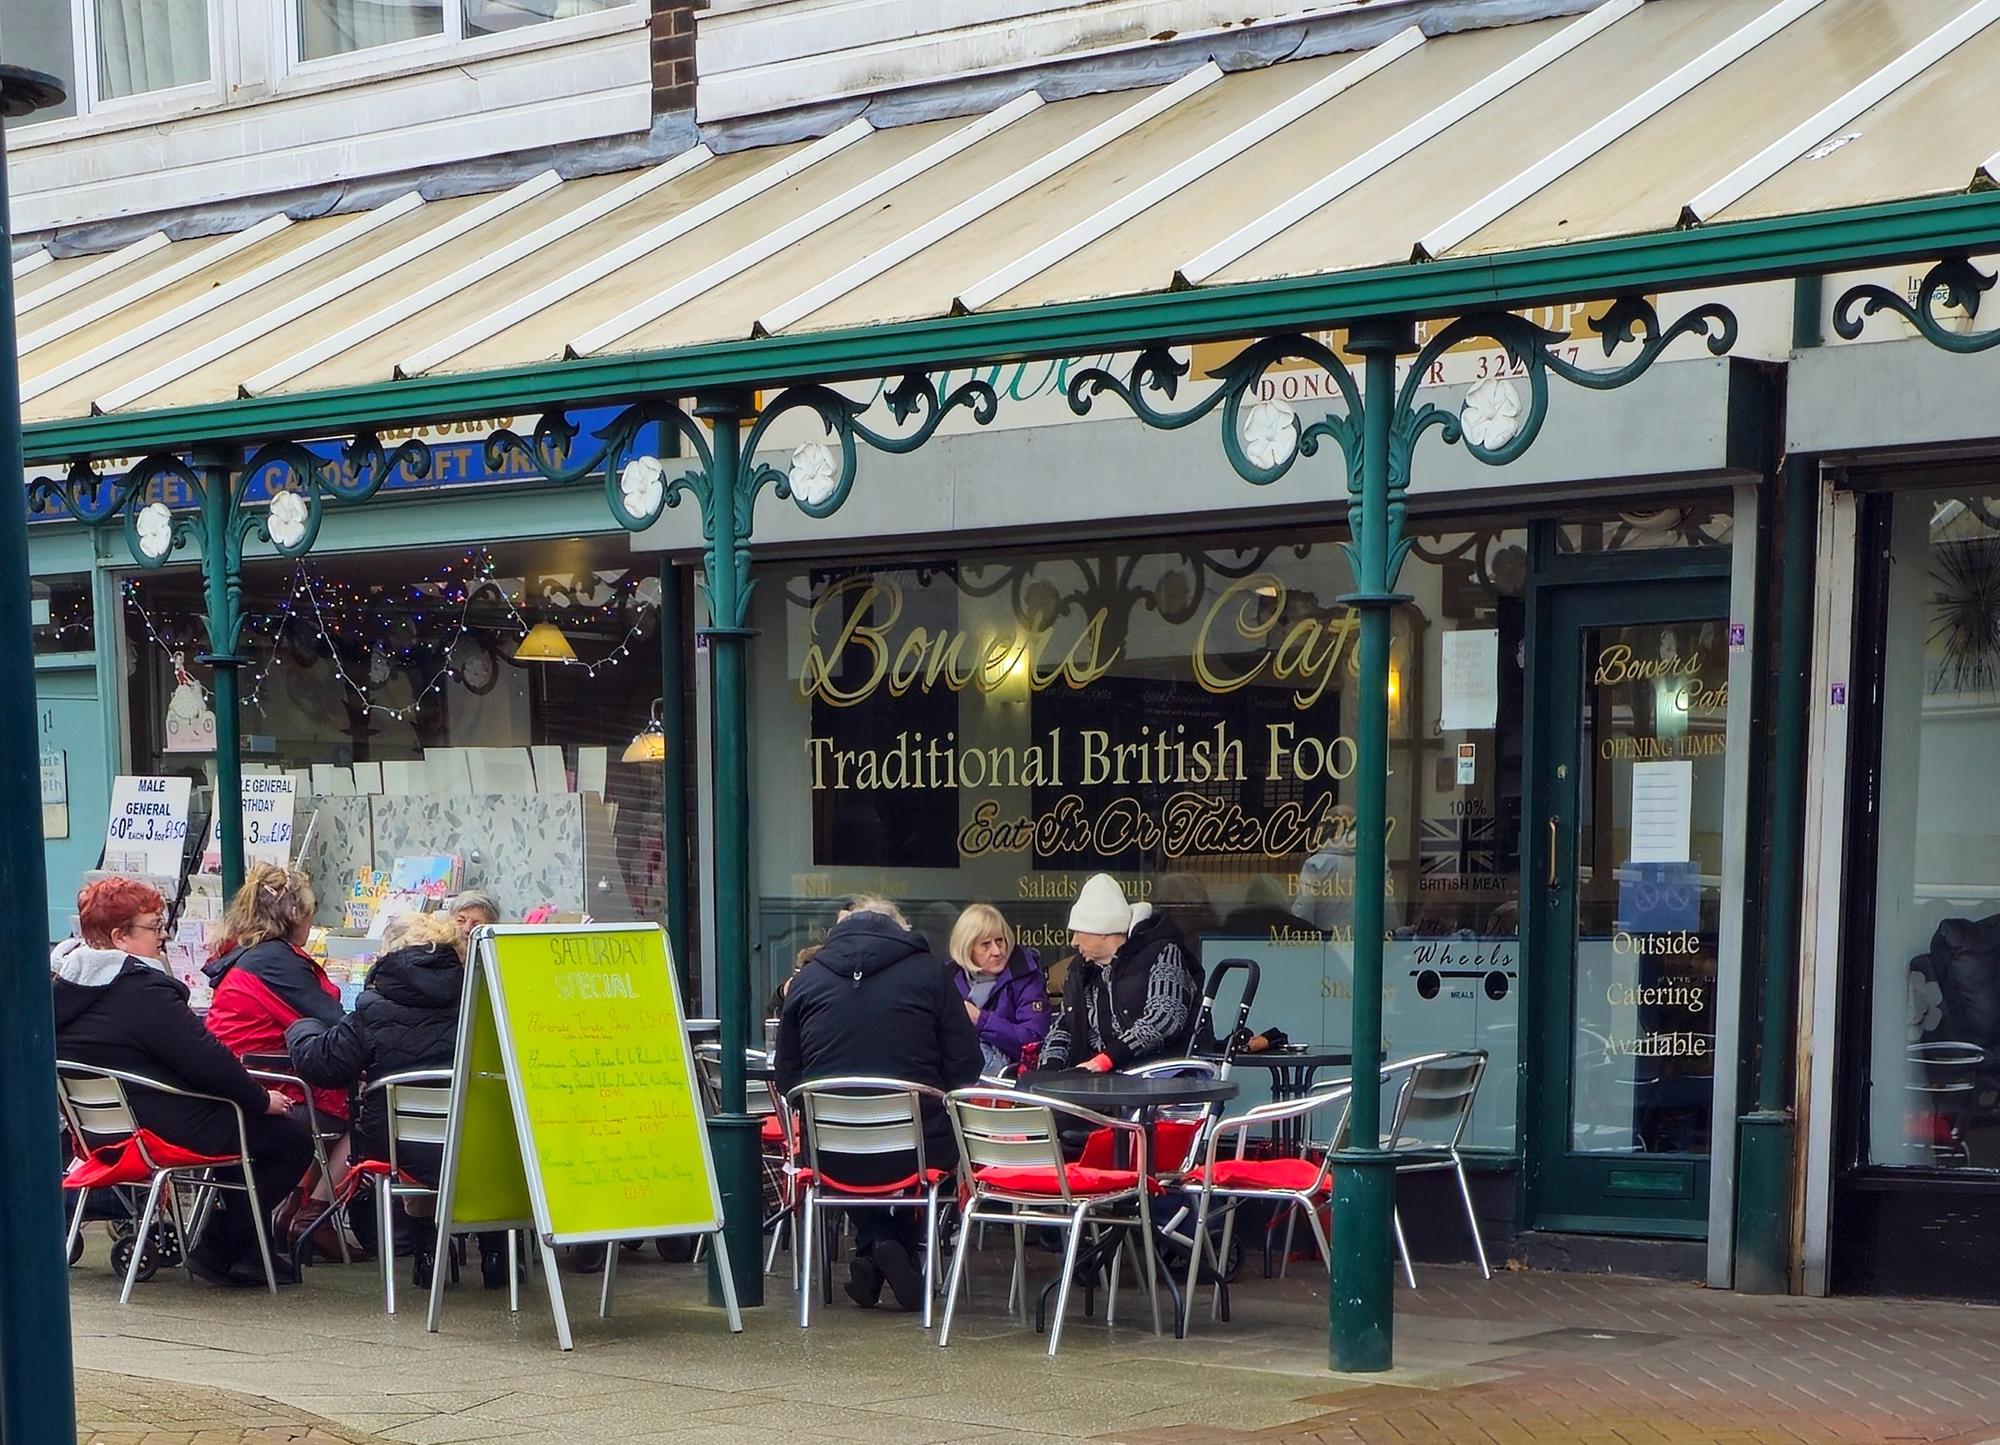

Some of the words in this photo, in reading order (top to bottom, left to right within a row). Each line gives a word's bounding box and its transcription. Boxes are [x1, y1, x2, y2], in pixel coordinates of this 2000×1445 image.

[800, 573, 1121, 708] Bowers
[1594, 644, 1702, 686] Bowers
[804, 726, 1063, 790] Traditional
[1080, 720, 1248, 785] British
[1264, 720, 1393, 781] Foo
[1602, 737, 1673, 760] OPENING
[1679, 733, 1727, 755] TIMES
[138, 780, 165, 793] MALE
[253, 779, 292, 793] GENERAL
[126, 803, 171, 816] GENERAL
[242, 798, 275, 812] RTHDAY
[1449, 800, 1487, 816] 100%
[145, 818, 154, 840] 3
[249, 821, 260, 844] 3
[958, 799, 1034, 858] Eat
[1018, 873, 1078, 898] Salads
[1419, 878, 1469, 891] BRITISH
[1473, 878, 1508, 890] MEAT
[550, 936, 650, 967] SATURDAY
[1612, 929, 1701, 955] Outside
[1414, 944, 1513, 967] Wheels
[1606, 980, 1704, 1012] Catering
[1603, 1031, 1706, 1057] Available
